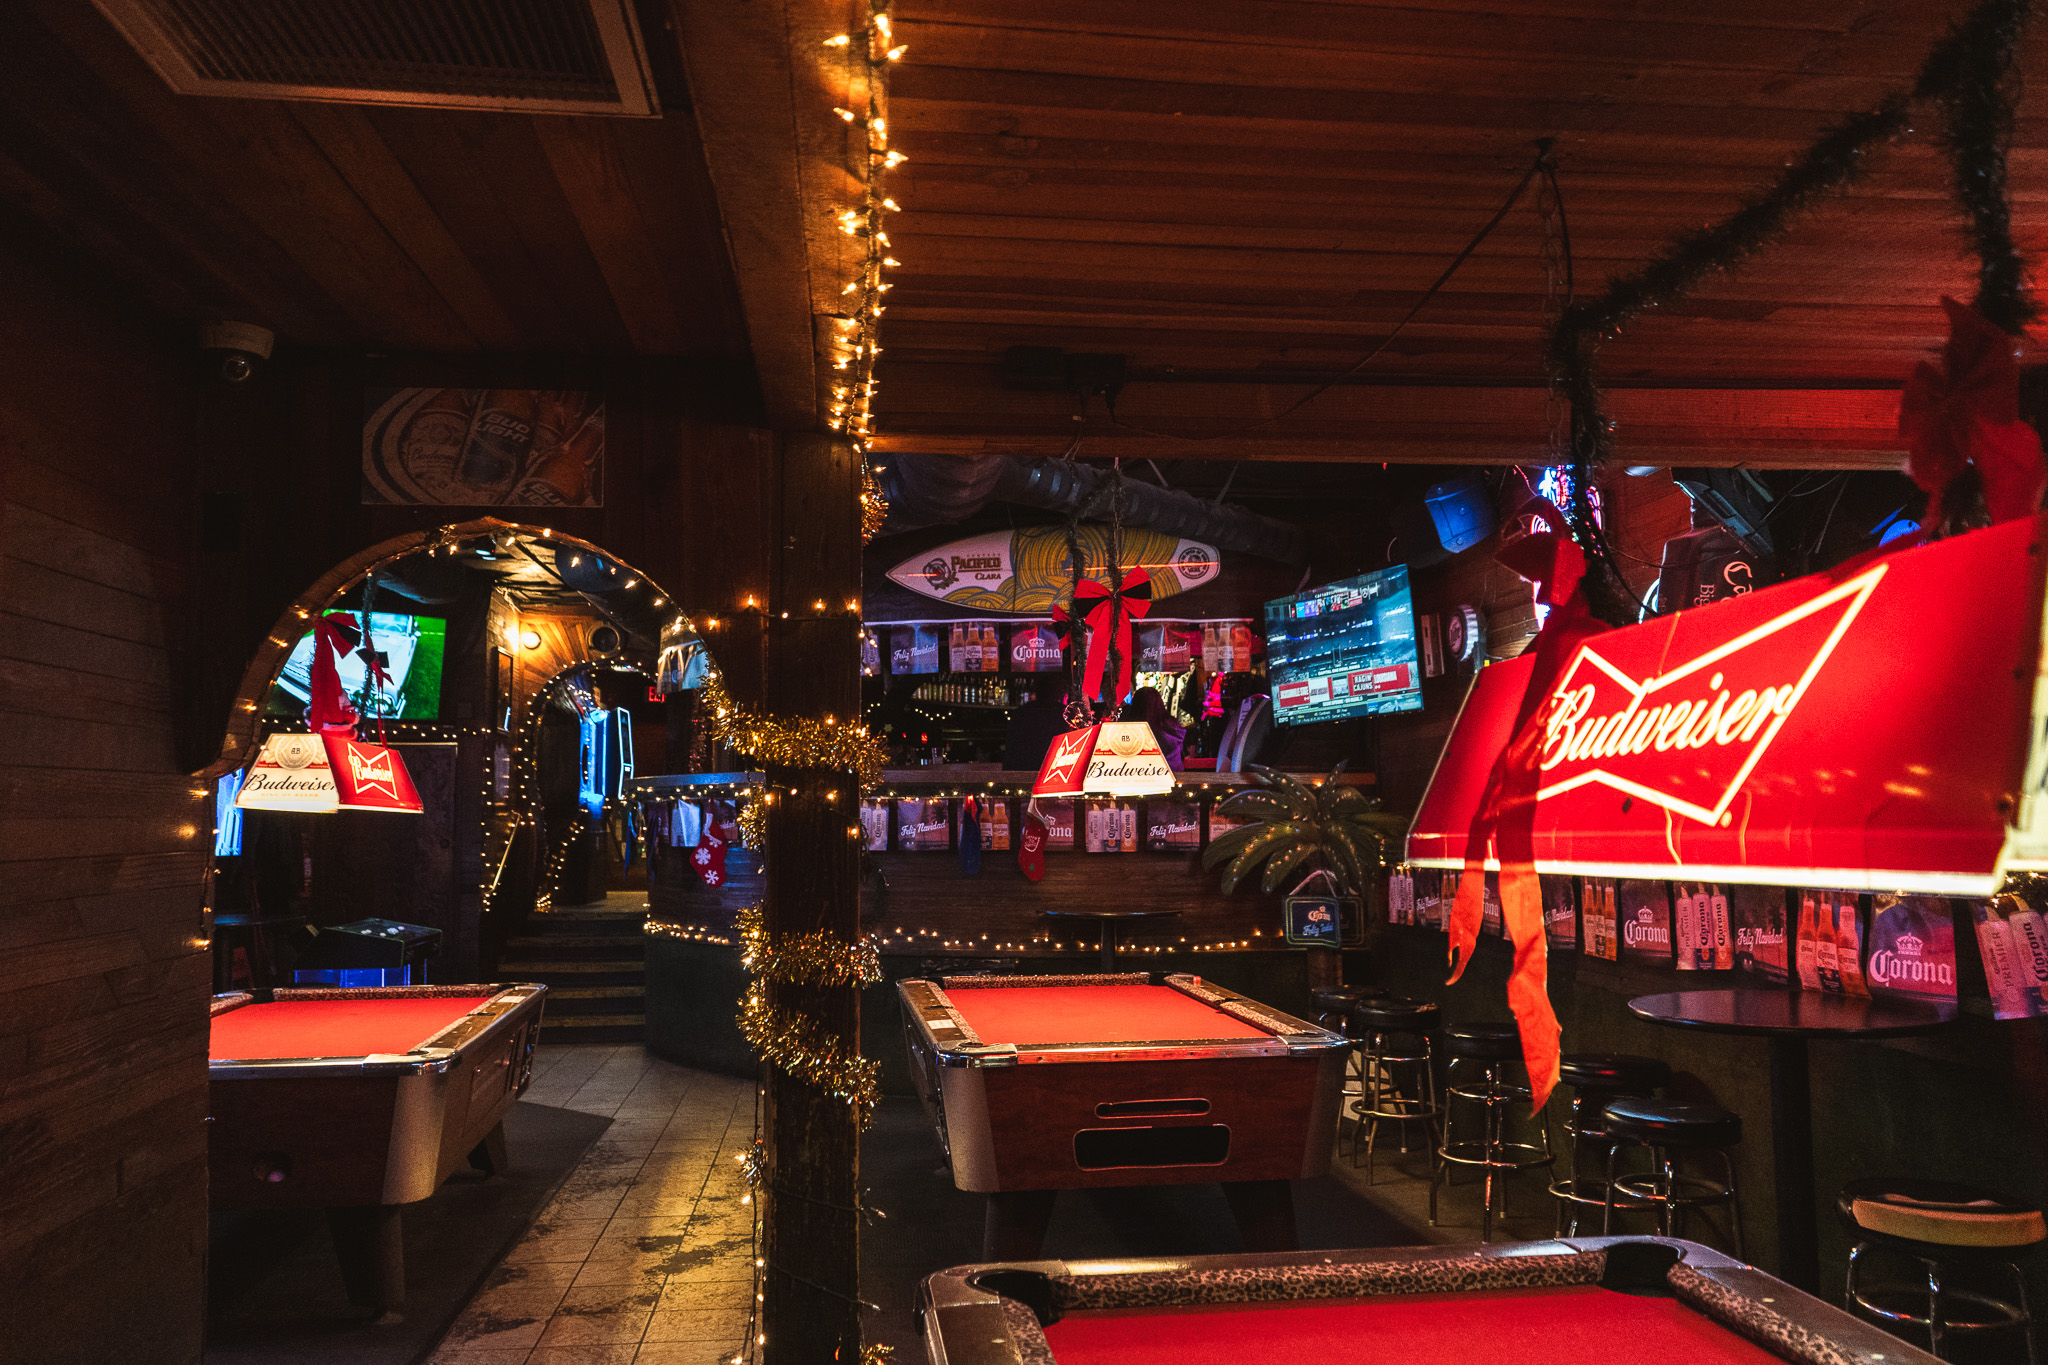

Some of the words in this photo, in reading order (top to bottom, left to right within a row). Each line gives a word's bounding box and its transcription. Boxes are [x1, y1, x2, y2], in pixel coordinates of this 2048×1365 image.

[484, 412, 530, 434] BUD
[893, 649, 910, 662] Feliz
[911, 643, 937, 657] Navidad
[1012, 645, 1061, 664] Corona
[1142, 647, 1159, 659] Feliz
[1159, 641, 1188, 656] Navidad
[1540, 672, 1796, 771] Budweiser
[1087, 760, 1170, 779] Budweiser
[246, 773, 336, 792] Budweiser
[900, 824, 917, 838] Feliz
[917, 819, 947, 834] Navidad
[1049, 827, 1073, 837] ona
[1107, 812, 1116, 839] Corona
[1124, 814, 1132, 839] Corona
[1149, 825, 1167, 838] Feliz
[1167, 821, 1197, 834] Navidad
[1624, 919, 1669, 948] Corona
[1699, 901, 1708, 946] Corona
[1716, 903, 1725, 946] Corona
[1737, 927, 1754, 952] Feliz
[1755, 927, 1784, 945] Navidad
[2023, 922, 2048, 982] Corona
[1869, 949, 1953, 987] Corona
